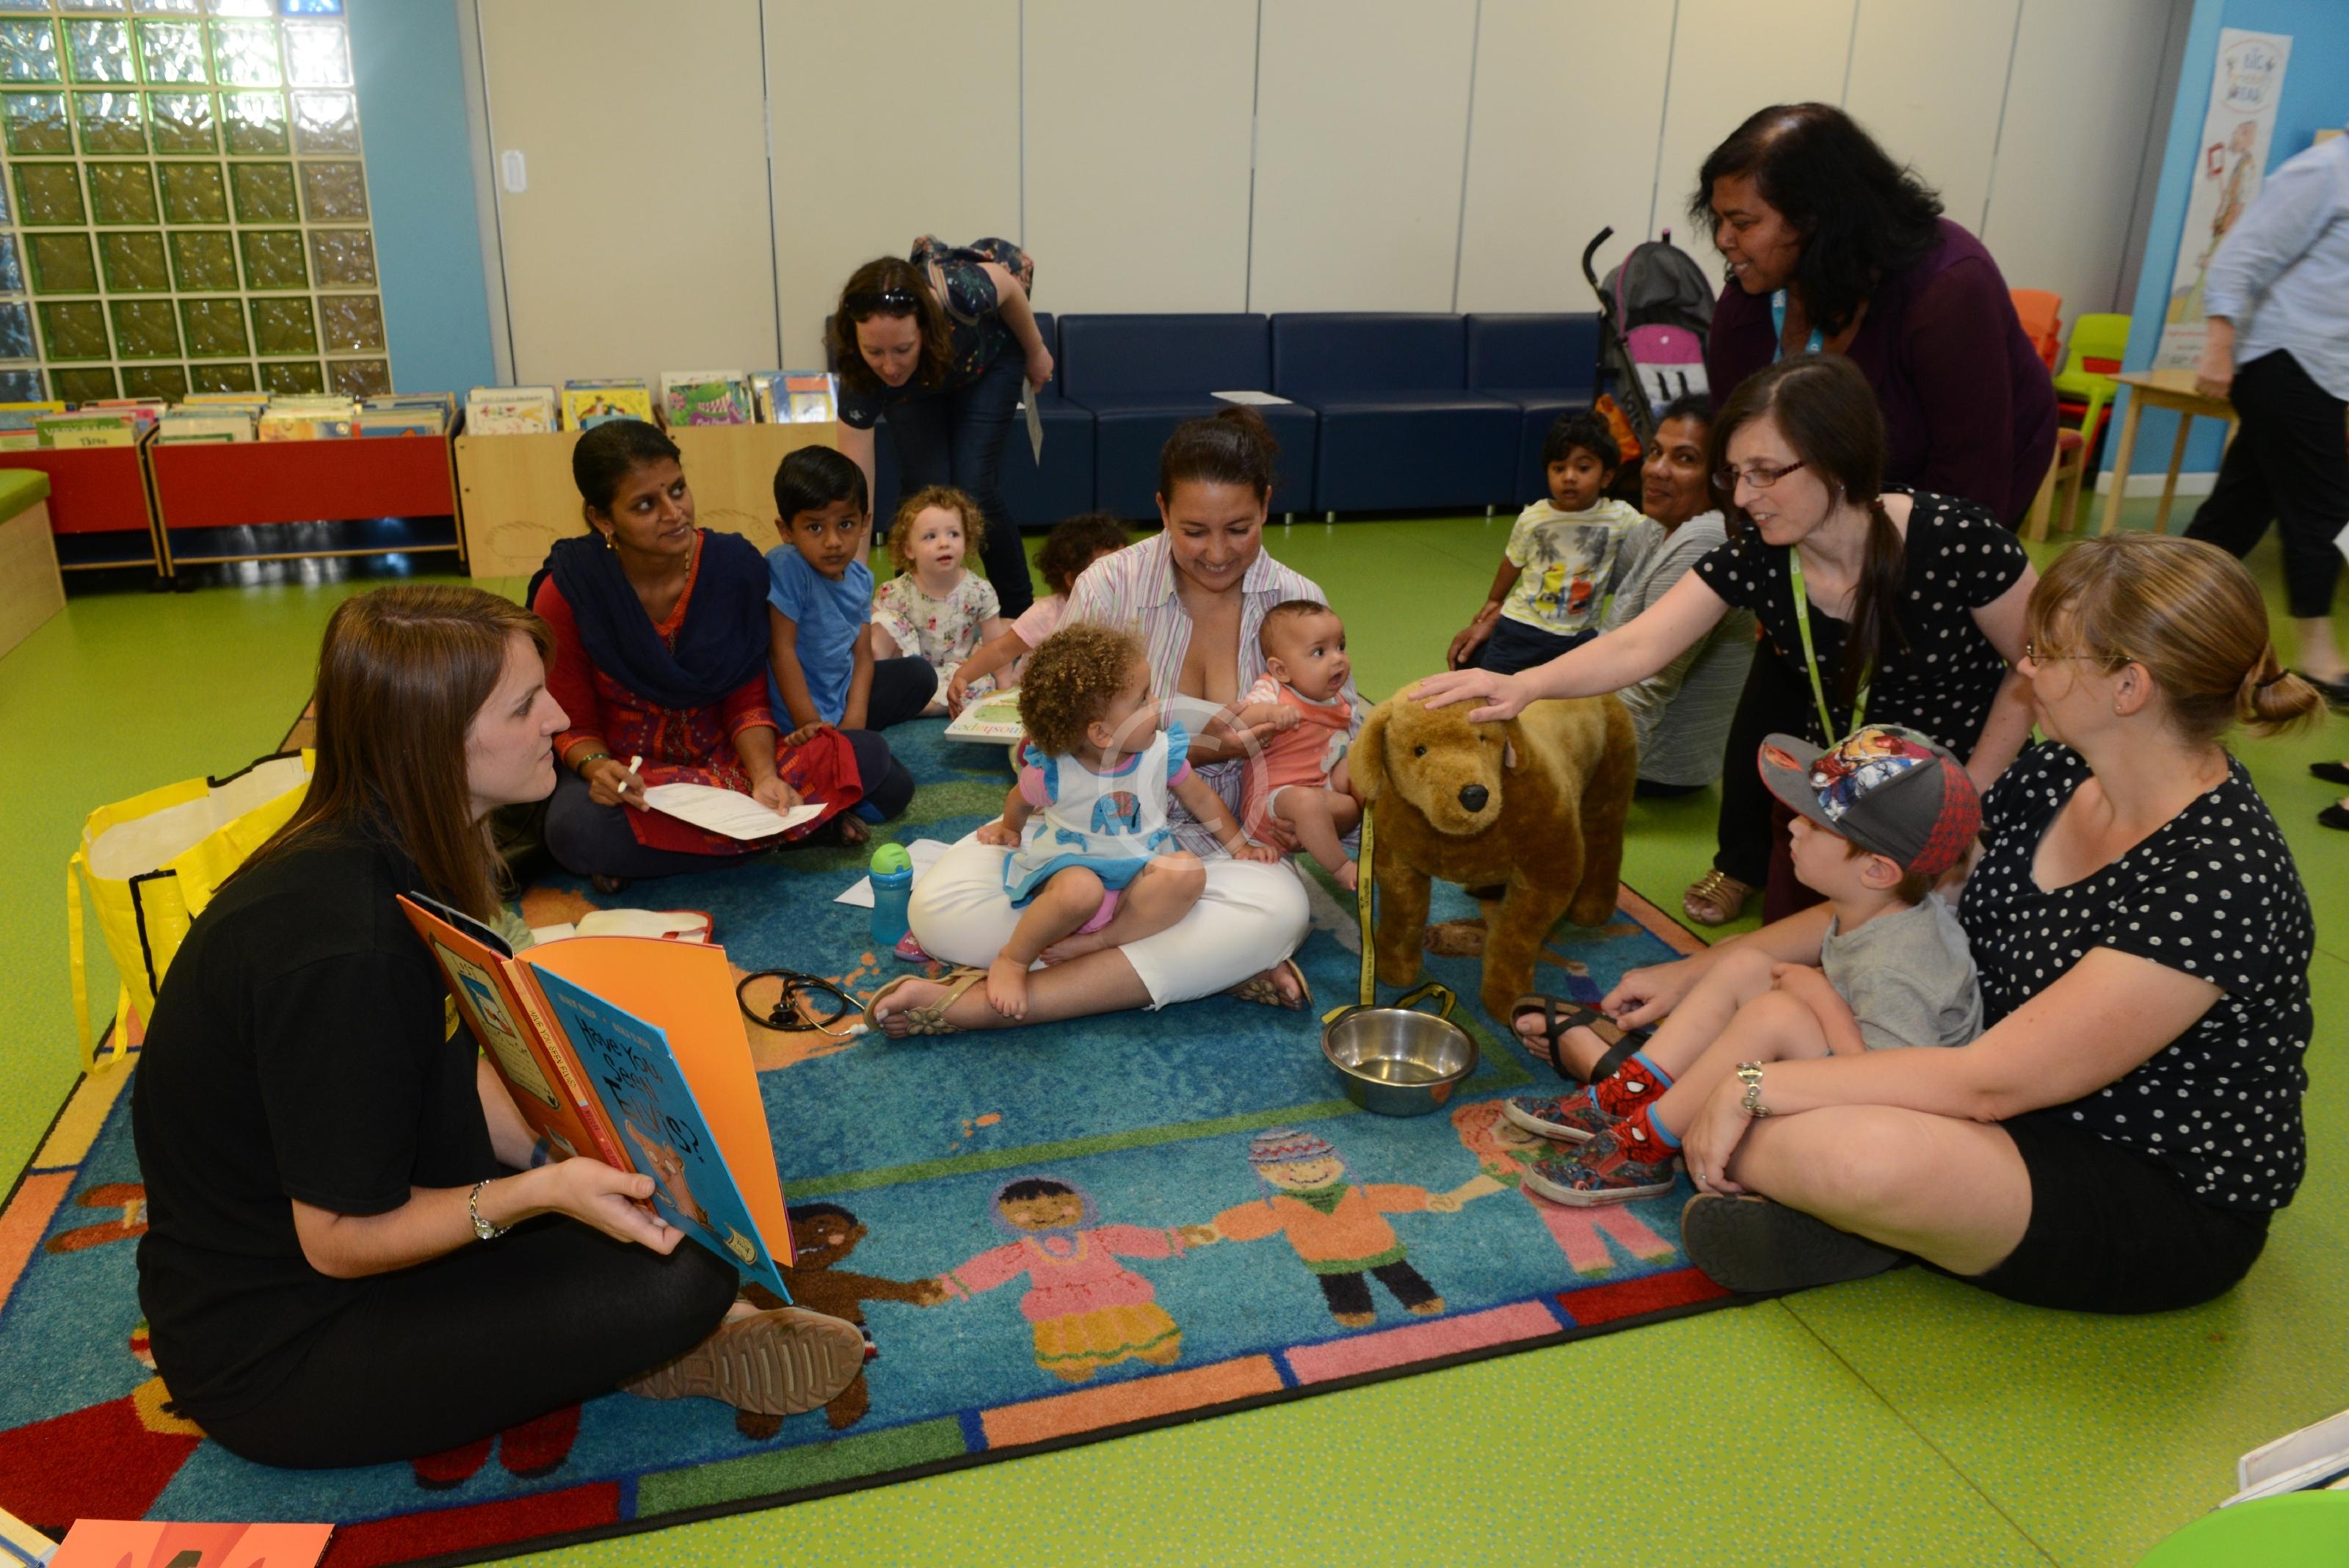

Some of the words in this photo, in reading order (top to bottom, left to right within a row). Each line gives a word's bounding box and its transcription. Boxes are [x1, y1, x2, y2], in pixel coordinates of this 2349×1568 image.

[531, 1010, 543, 1028] HAVE
[540, 1029, 551, 1044] YOU
[549, 1045, 563, 1064] SEEN
[575, 1014, 622, 1056] Have
